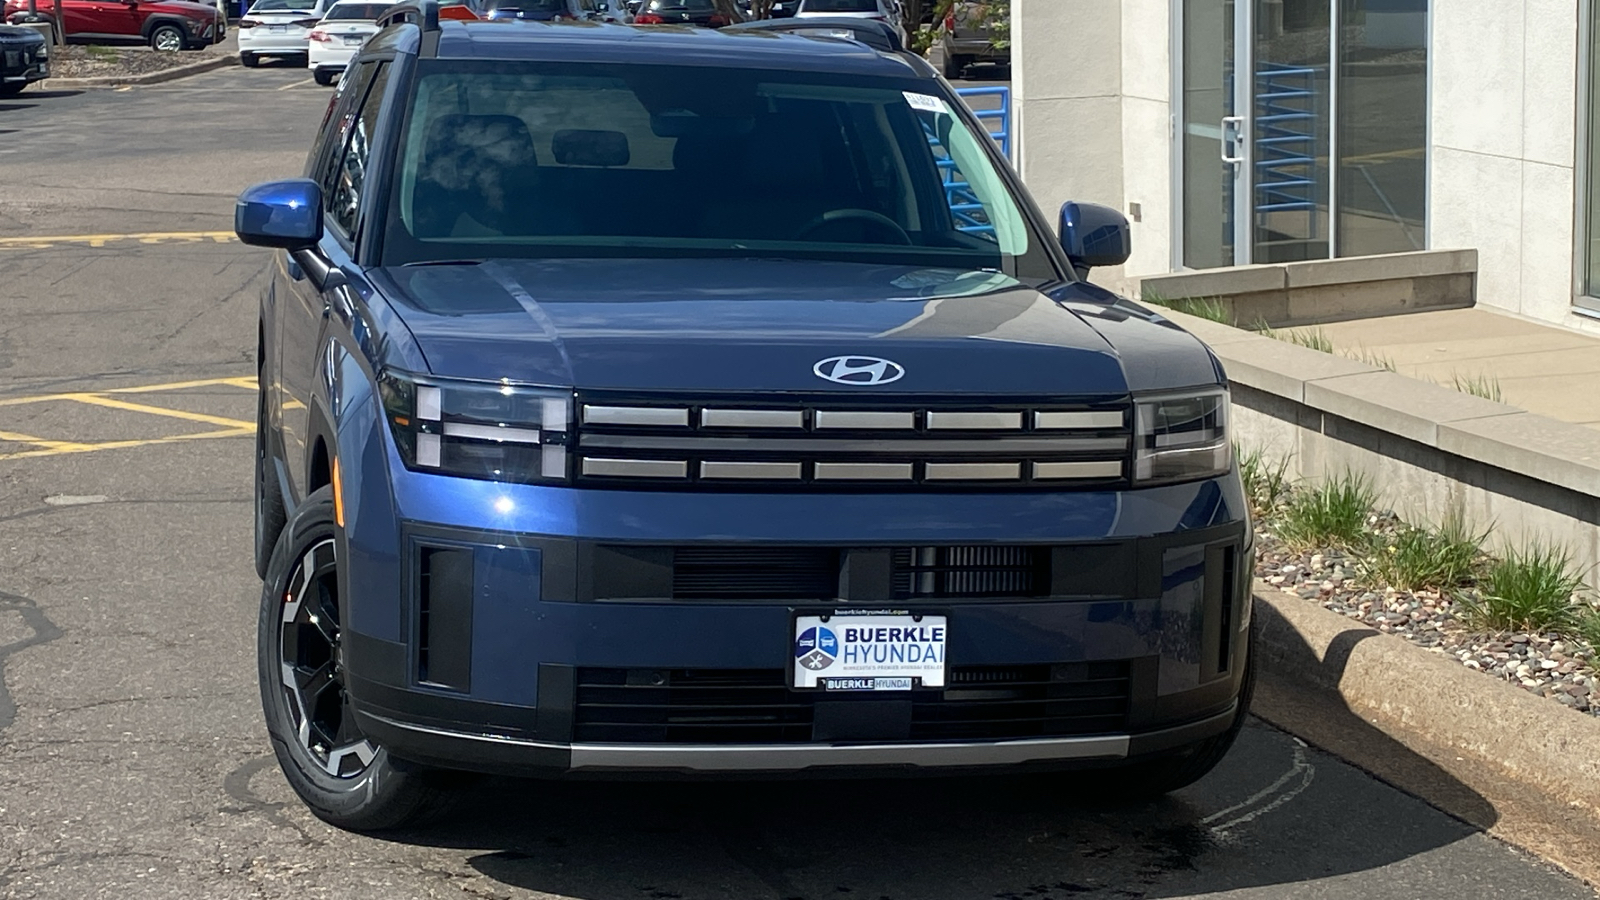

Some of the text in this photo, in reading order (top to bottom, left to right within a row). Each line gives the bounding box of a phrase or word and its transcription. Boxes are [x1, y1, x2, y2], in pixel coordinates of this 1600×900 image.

[845, 627, 944, 643] BUERKLE
[844, 644, 943, 663] HYUNDAI
[827, 679, 910, 689] BUERKLE HYUNDAI
